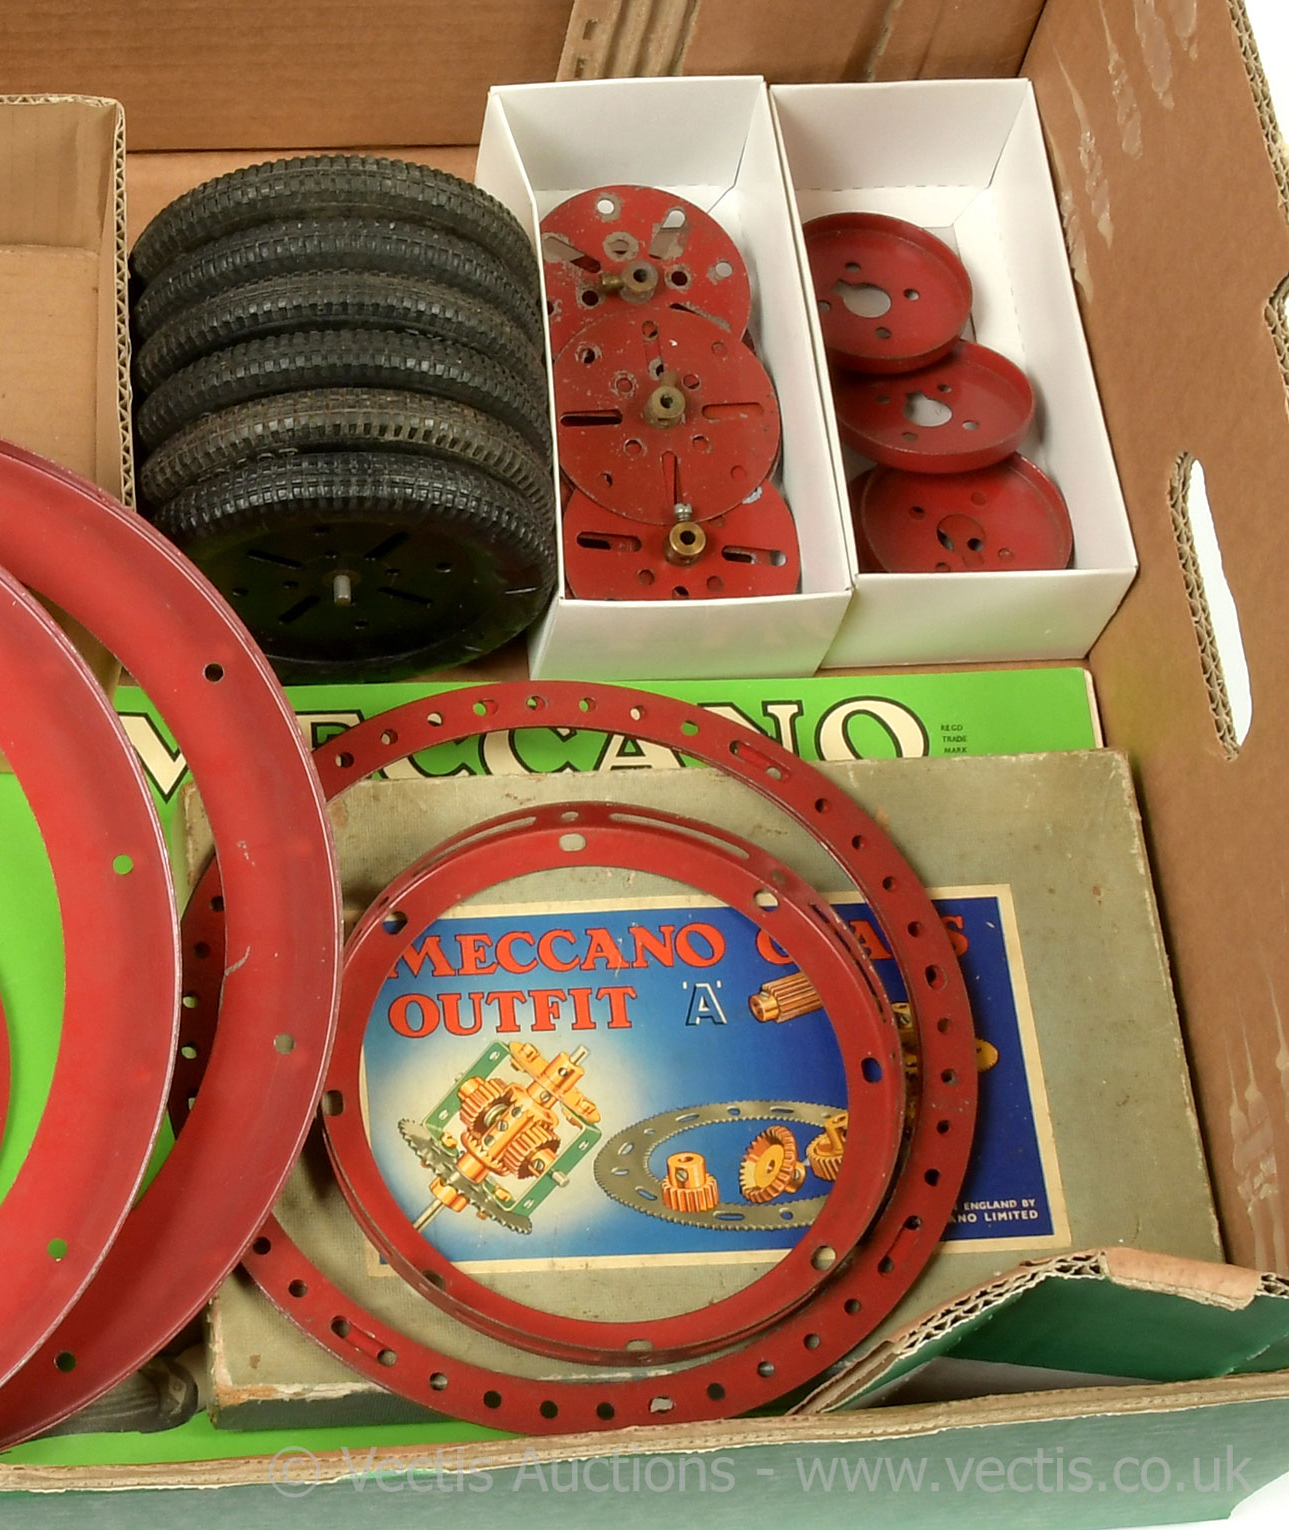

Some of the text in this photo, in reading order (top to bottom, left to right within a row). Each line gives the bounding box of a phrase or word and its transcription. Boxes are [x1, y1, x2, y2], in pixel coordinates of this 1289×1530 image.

[940, 724, 964, 732] REGD
[943, 735, 967, 743] TRADE
[944, 746, 968, 754] MARK
[387, 921, 727, 980] MECCANO
[387, 986, 638, 1039] OUTFIT
[963, 1198, 1036, 1211] ENGLAND BY
[984, 1209, 1039, 1222] LIMITED
